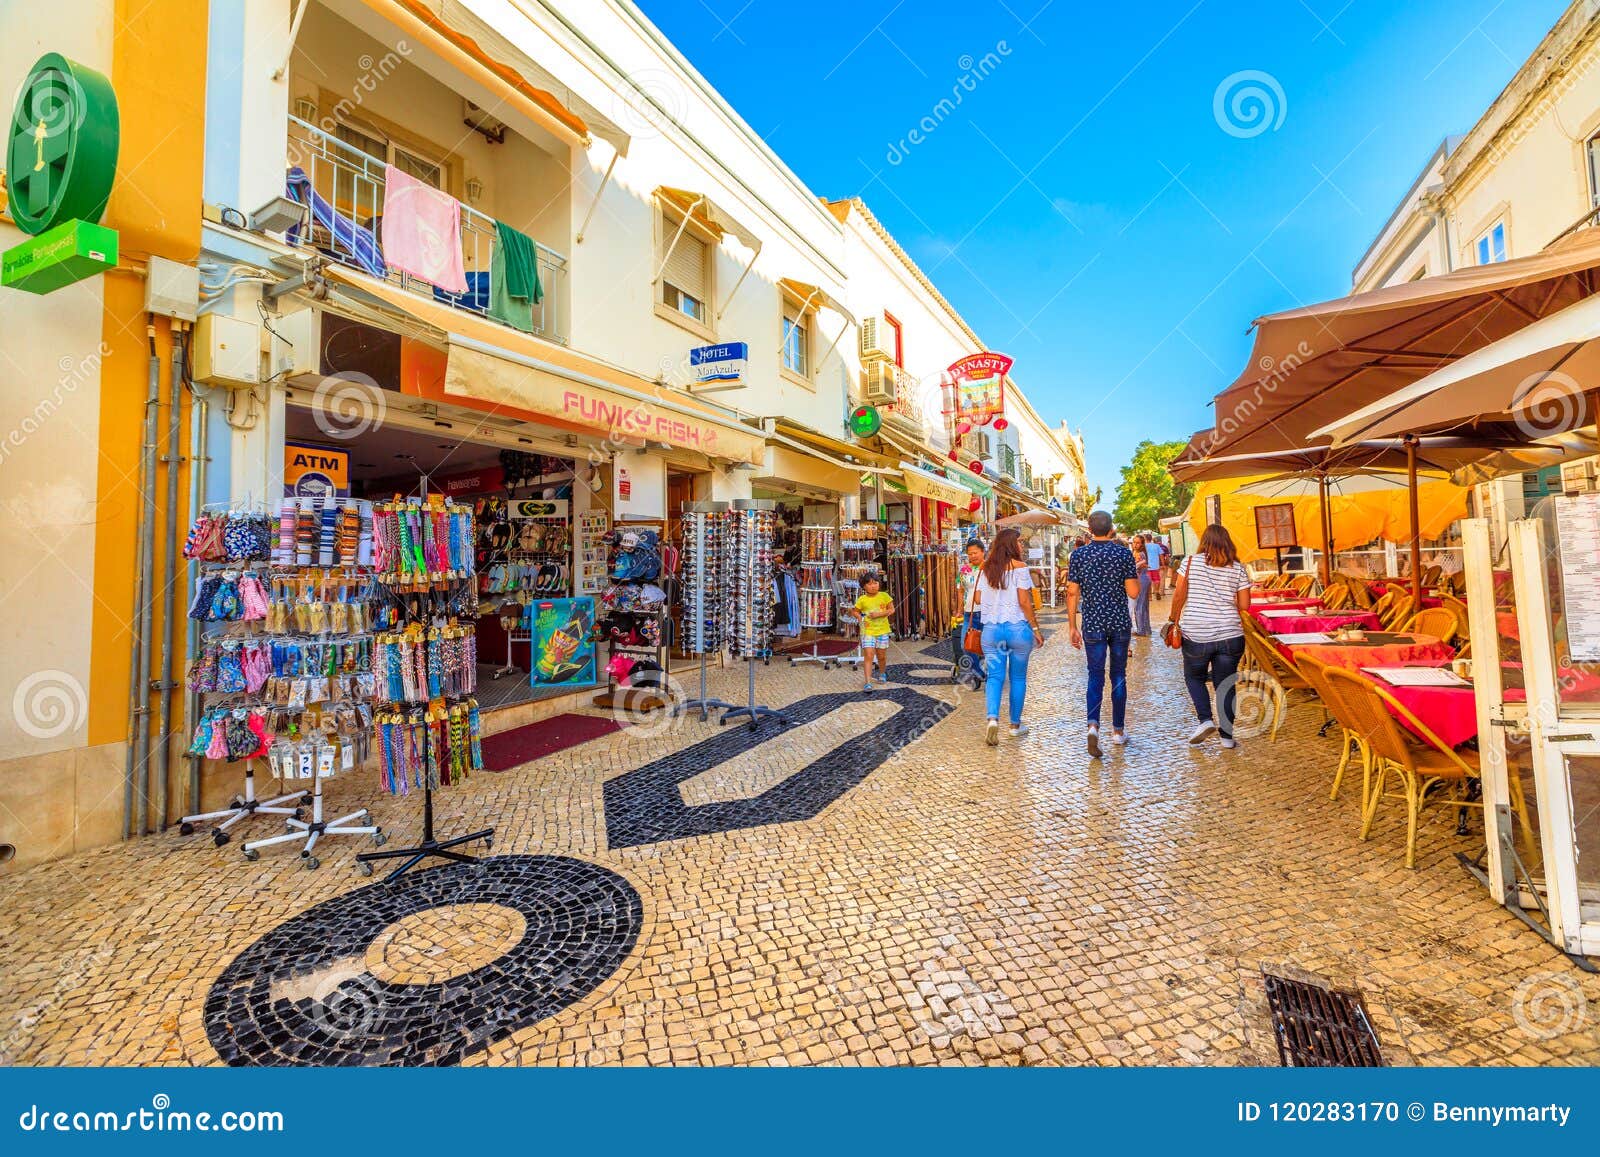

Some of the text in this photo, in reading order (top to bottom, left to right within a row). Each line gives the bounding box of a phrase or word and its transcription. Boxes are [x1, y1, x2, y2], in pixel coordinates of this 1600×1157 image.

[700, 347, 732, 361] HOTEL
[951, 359, 1007, 378] DYNASTY
[563, 390, 651, 433] FUNKY
[292, 453, 339, 471] ATM
